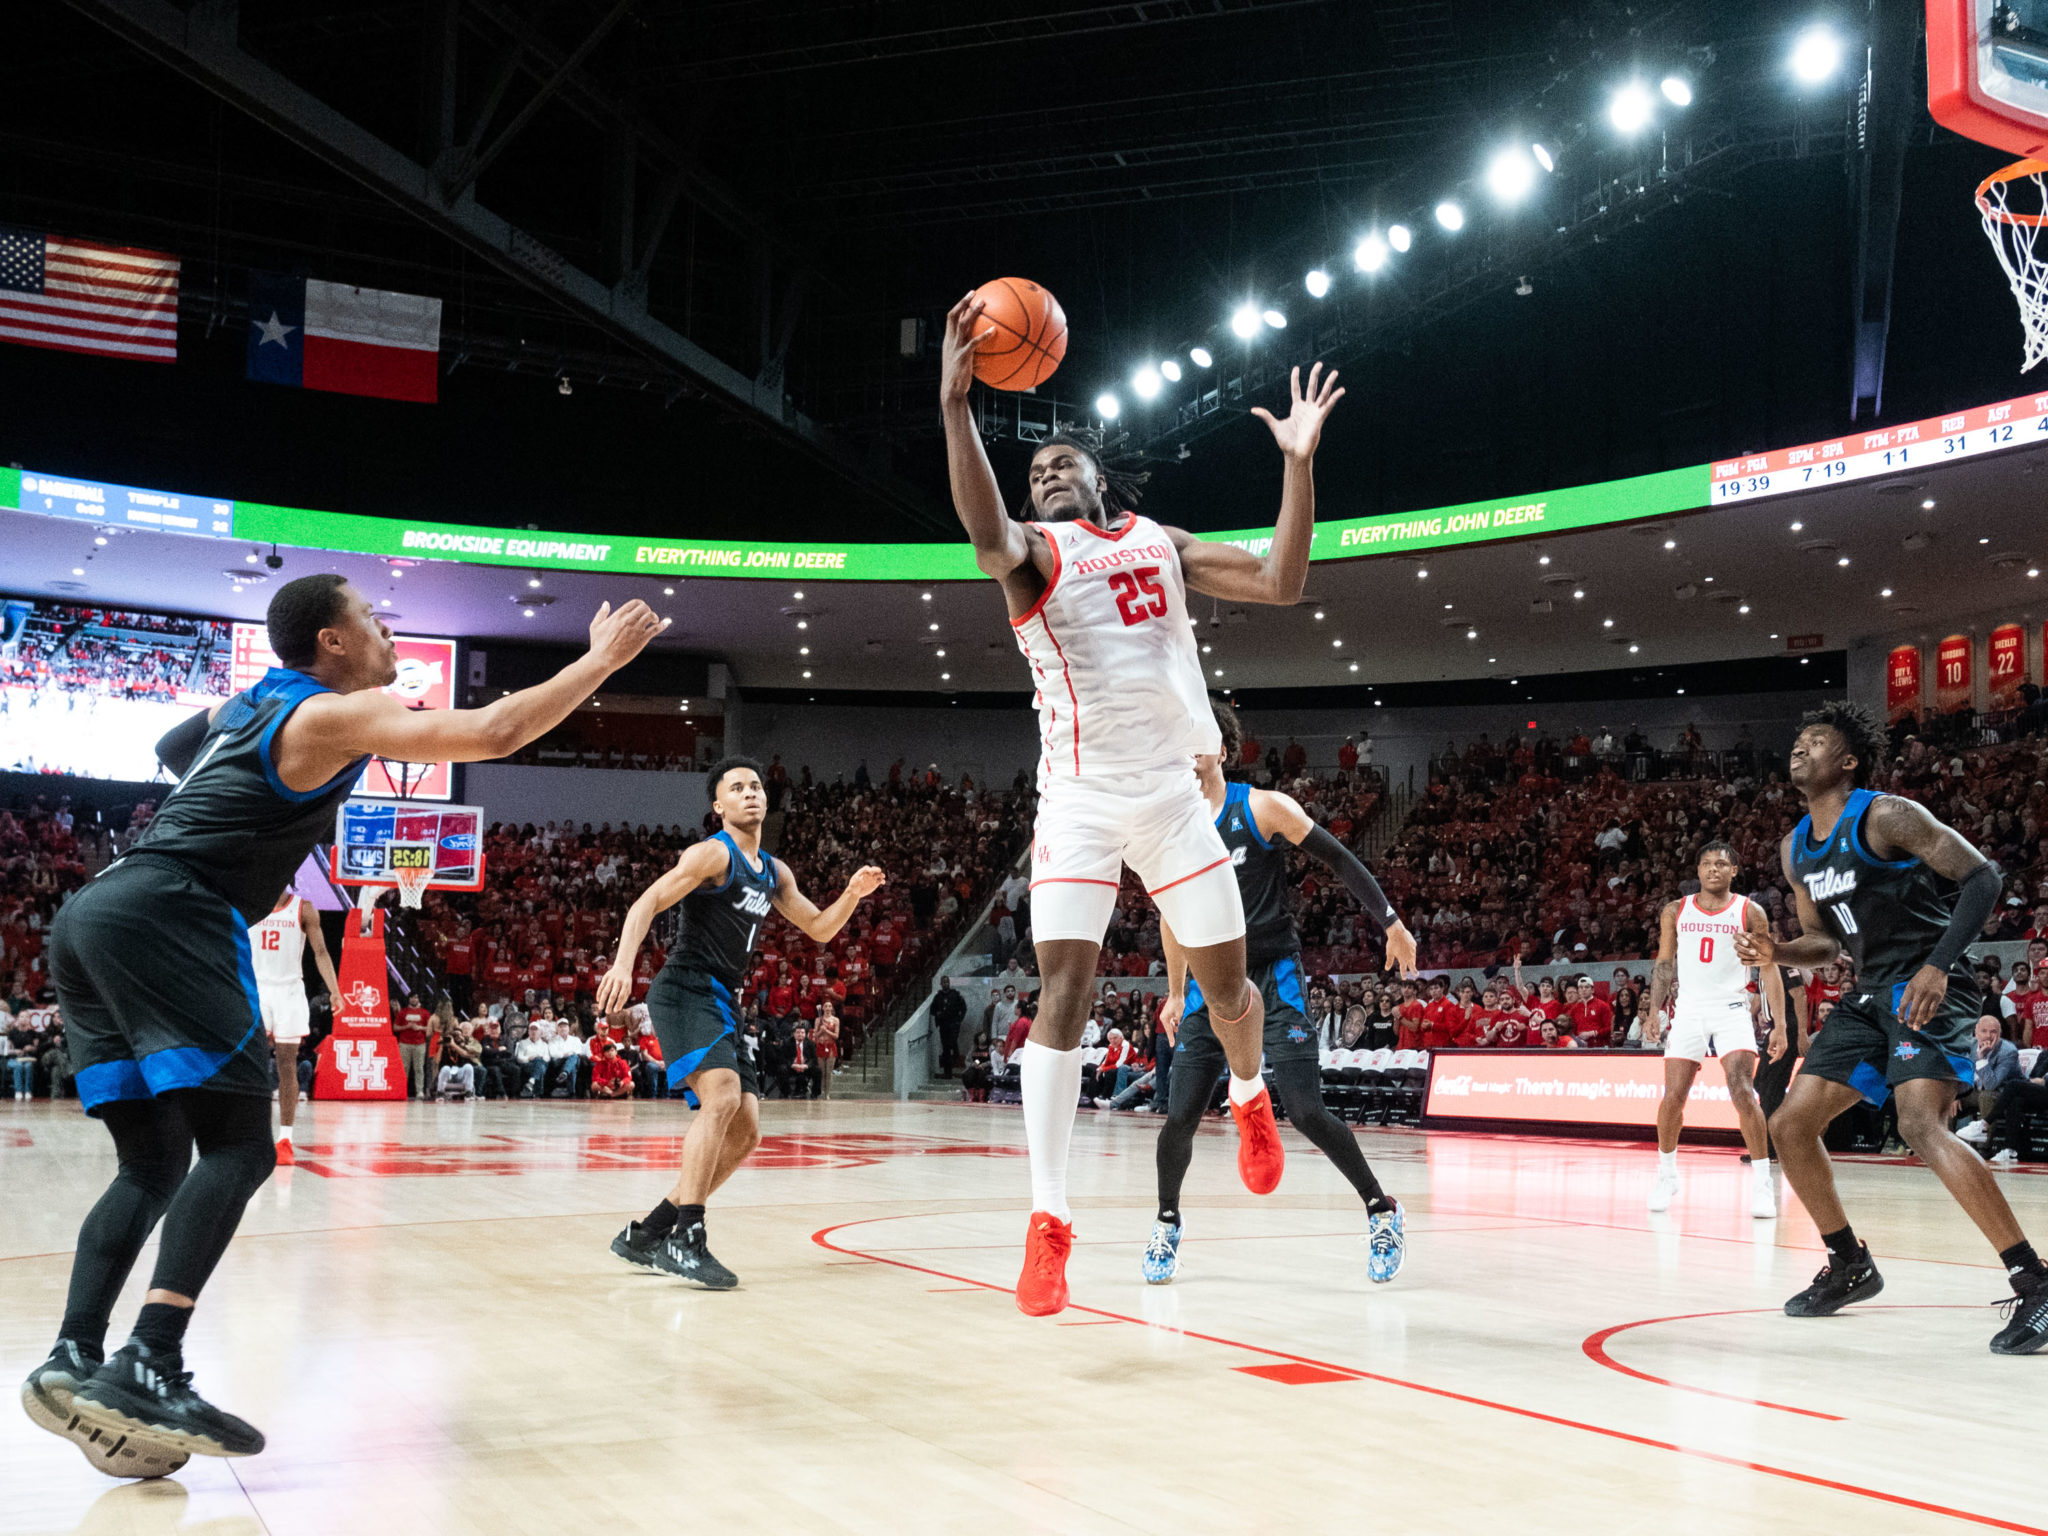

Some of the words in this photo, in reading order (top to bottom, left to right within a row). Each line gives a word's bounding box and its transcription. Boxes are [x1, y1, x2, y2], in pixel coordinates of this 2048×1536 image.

[1941, 416, 1965, 433] REB
[1987, 405, 2012, 423] AST
[1944, 435, 1965, 454] 31
[1989, 425, 2013, 443] 12
[128, 491, 180, 510] TEMPLE
[1340, 517, 1442, 547] EVERYTHING
[1443, 511, 1490, 535] JOHN
[1492, 502, 1548, 528] DEERE
[402, 530, 505, 556] BROOKSIDE
[505, 538, 611, 562] EQUIPMENT
[635, 546, 743, 567] EVERYTHING
[742, 551, 791, 568] JOHN
[793, 552, 848, 569] DEERE
[1072, 544, 1170, 575] HOUSTON
[1108, 566, 1168, 627] 25
[1946, 661, 1962, 684] 10
[1997, 651, 2015, 675] 22
[1803, 866, 1857, 903] Tulsa
[261, 929, 281, 951] 12
[746, 923, 757, 953] 1
[1680, 922, 1739, 935] HOUSTON
[1699, 936, 1715, 964] 0
[333, 1040, 389, 1091] UH
[1515, 1077, 1564, 1096] There's
[1567, 1078, 1613, 1101] magic
[1614, 1079, 1657, 1099] when
[1690, 1081, 1732, 1102] chee
